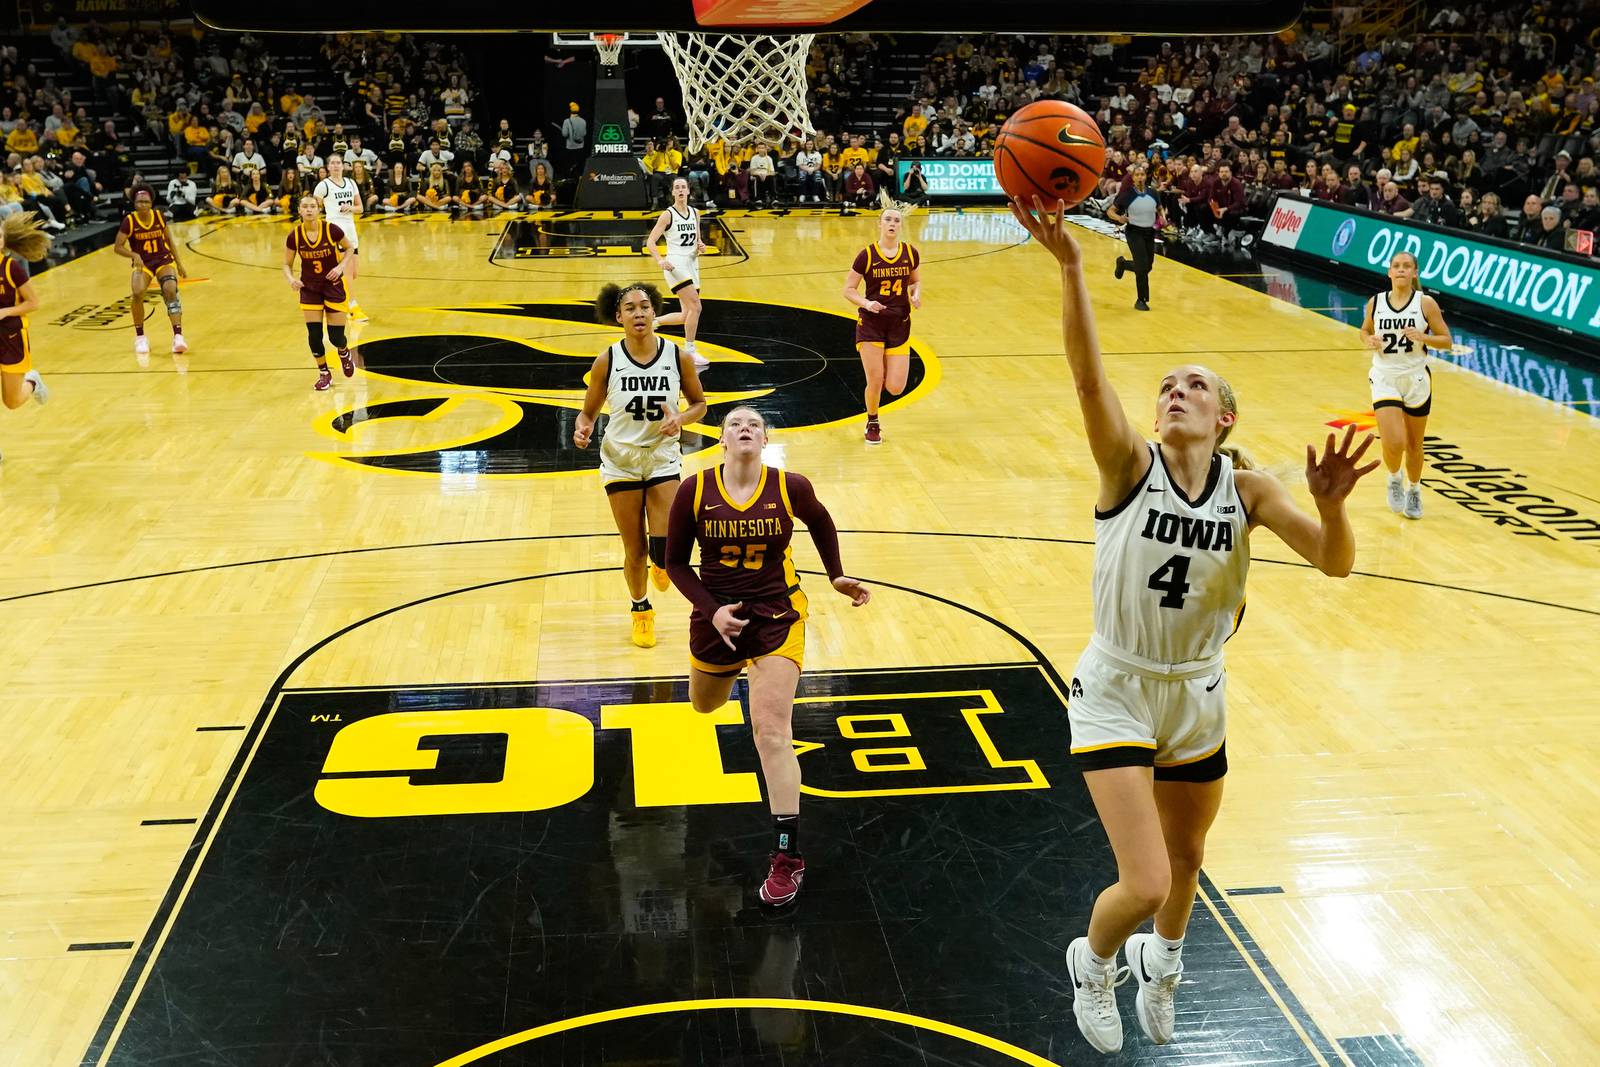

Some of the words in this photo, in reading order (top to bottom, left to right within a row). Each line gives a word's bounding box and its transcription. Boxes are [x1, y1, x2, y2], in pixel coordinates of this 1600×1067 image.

[926, 178, 987, 190] REIGHT
[143, 240, 158, 253] 41
[680, 233, 696, 247] 22
[312, 260, 323, 274] 3
[872, 266, 910, 278] MINNESOTA
[879, 279, 903, 296] 24
[1420, 240, 1593, 320] DOMINION
[1379, 318, 1416, 330] IOWA
[1382, 333, 1414, 354] 24
[621, 376, 671, 391] IOWA
[625, 395, 667, 422] 45
[704, 517, 783, 538] MINNESOTA
[1140, 507, 1233, 552] IOWA
[1147, 554, 1191, 610] 4
